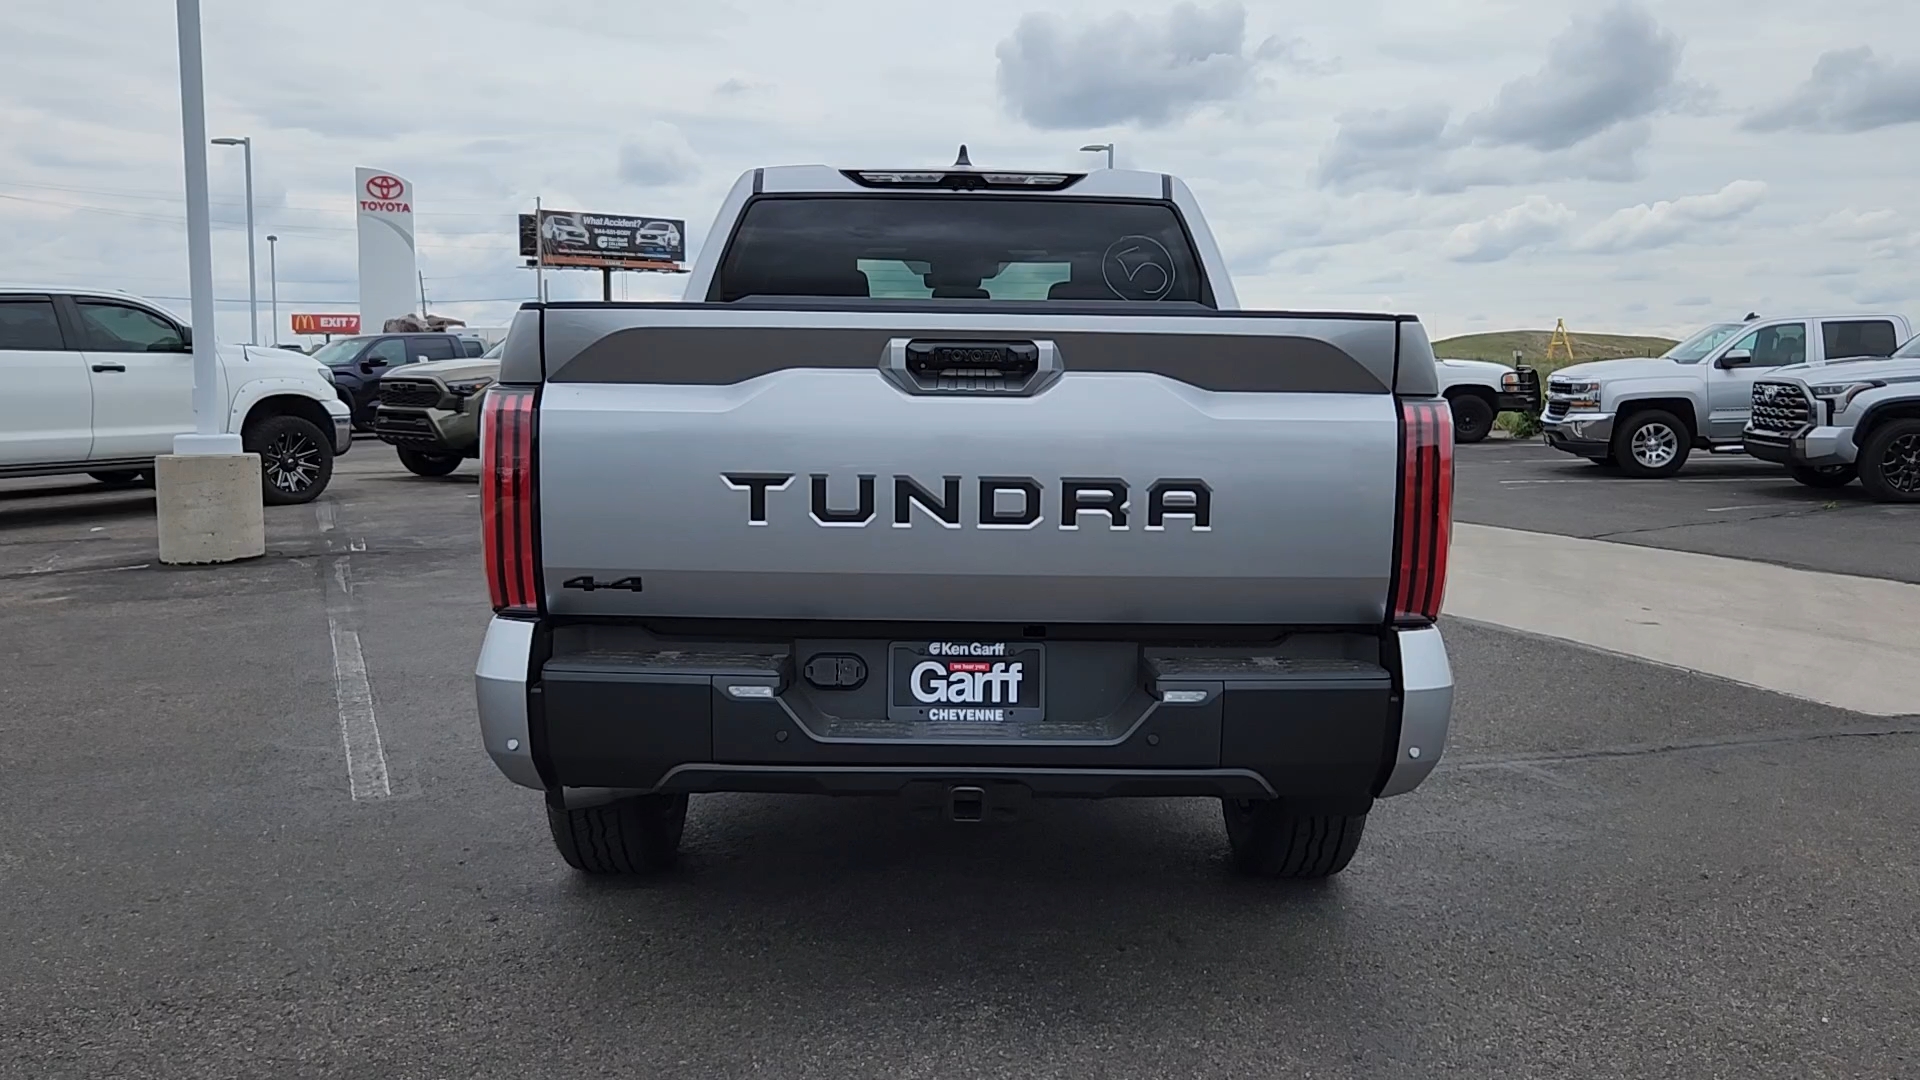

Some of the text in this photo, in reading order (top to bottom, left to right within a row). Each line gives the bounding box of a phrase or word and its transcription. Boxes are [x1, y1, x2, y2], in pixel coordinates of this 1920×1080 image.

[360, 201, 411, 213] TOYOTA
[583, 216, 642, 229] What Accident?
[320, 317, 348, 327] EXIT
[349, 317, 358, 328] 7
[941, 349, 1002, 362] TOYOTA
[720, 472, 1214, 531] TUNDRA
[941, 642, 1005, 655] Ken Garff
[910, 661, 1023, 703] Garff
[929, 709, 1004, 721] CHEYENNE
